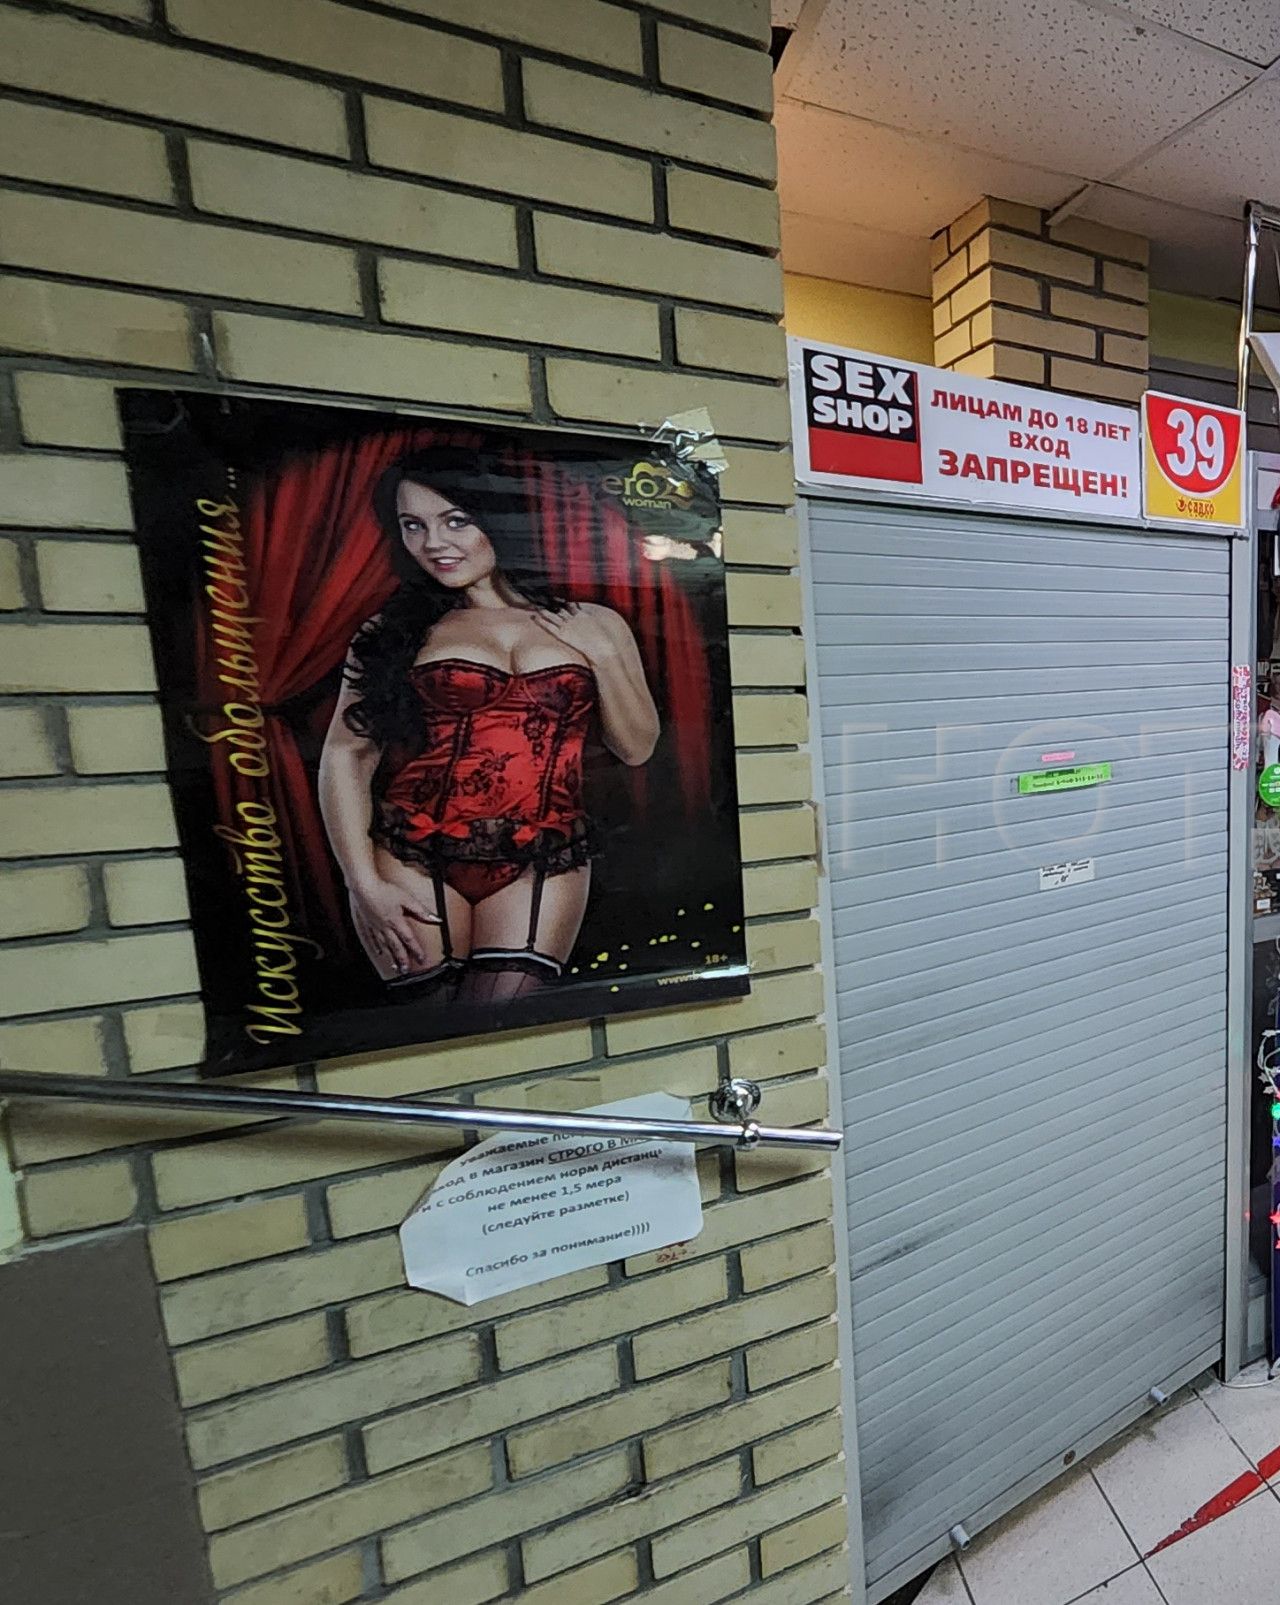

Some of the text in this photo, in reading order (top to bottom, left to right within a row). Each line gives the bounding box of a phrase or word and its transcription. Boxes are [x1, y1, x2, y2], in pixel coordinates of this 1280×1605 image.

[808, 354, 914, 406] SEX
[812, 394, 914, 436] SHOP
[929, 389, 1132, 443] ЛИЦАМ ДО 18 ЛЕТ
[1008, 430, 1072, 460] ВХОД
[1166, 408, 1225, 481] 39
[937, 448, 1129, 500] ЗАПРЕЩЕН!
[622, 497, 672, 510] woman
[212, 797, 326, 1045] Искусство
[705, 953, 728, 965] 18+
[448, 1174, 557, 1205] соблюдением
[560, 1164, 599, 1177] норм
[601, 1148, 663, 1172] дистанц
[482, 1155, 544, 1177] магазин
[547, 1142, 604, 1163] СТРОГО
[481, 1190, 630, 1236] (следуйте разметке)
[487, 1175, 623, 1213] не менее 1,5 мера
[465, 1254, 528, 1278] Спасибо
[531, 1250, 548, 1260] за
